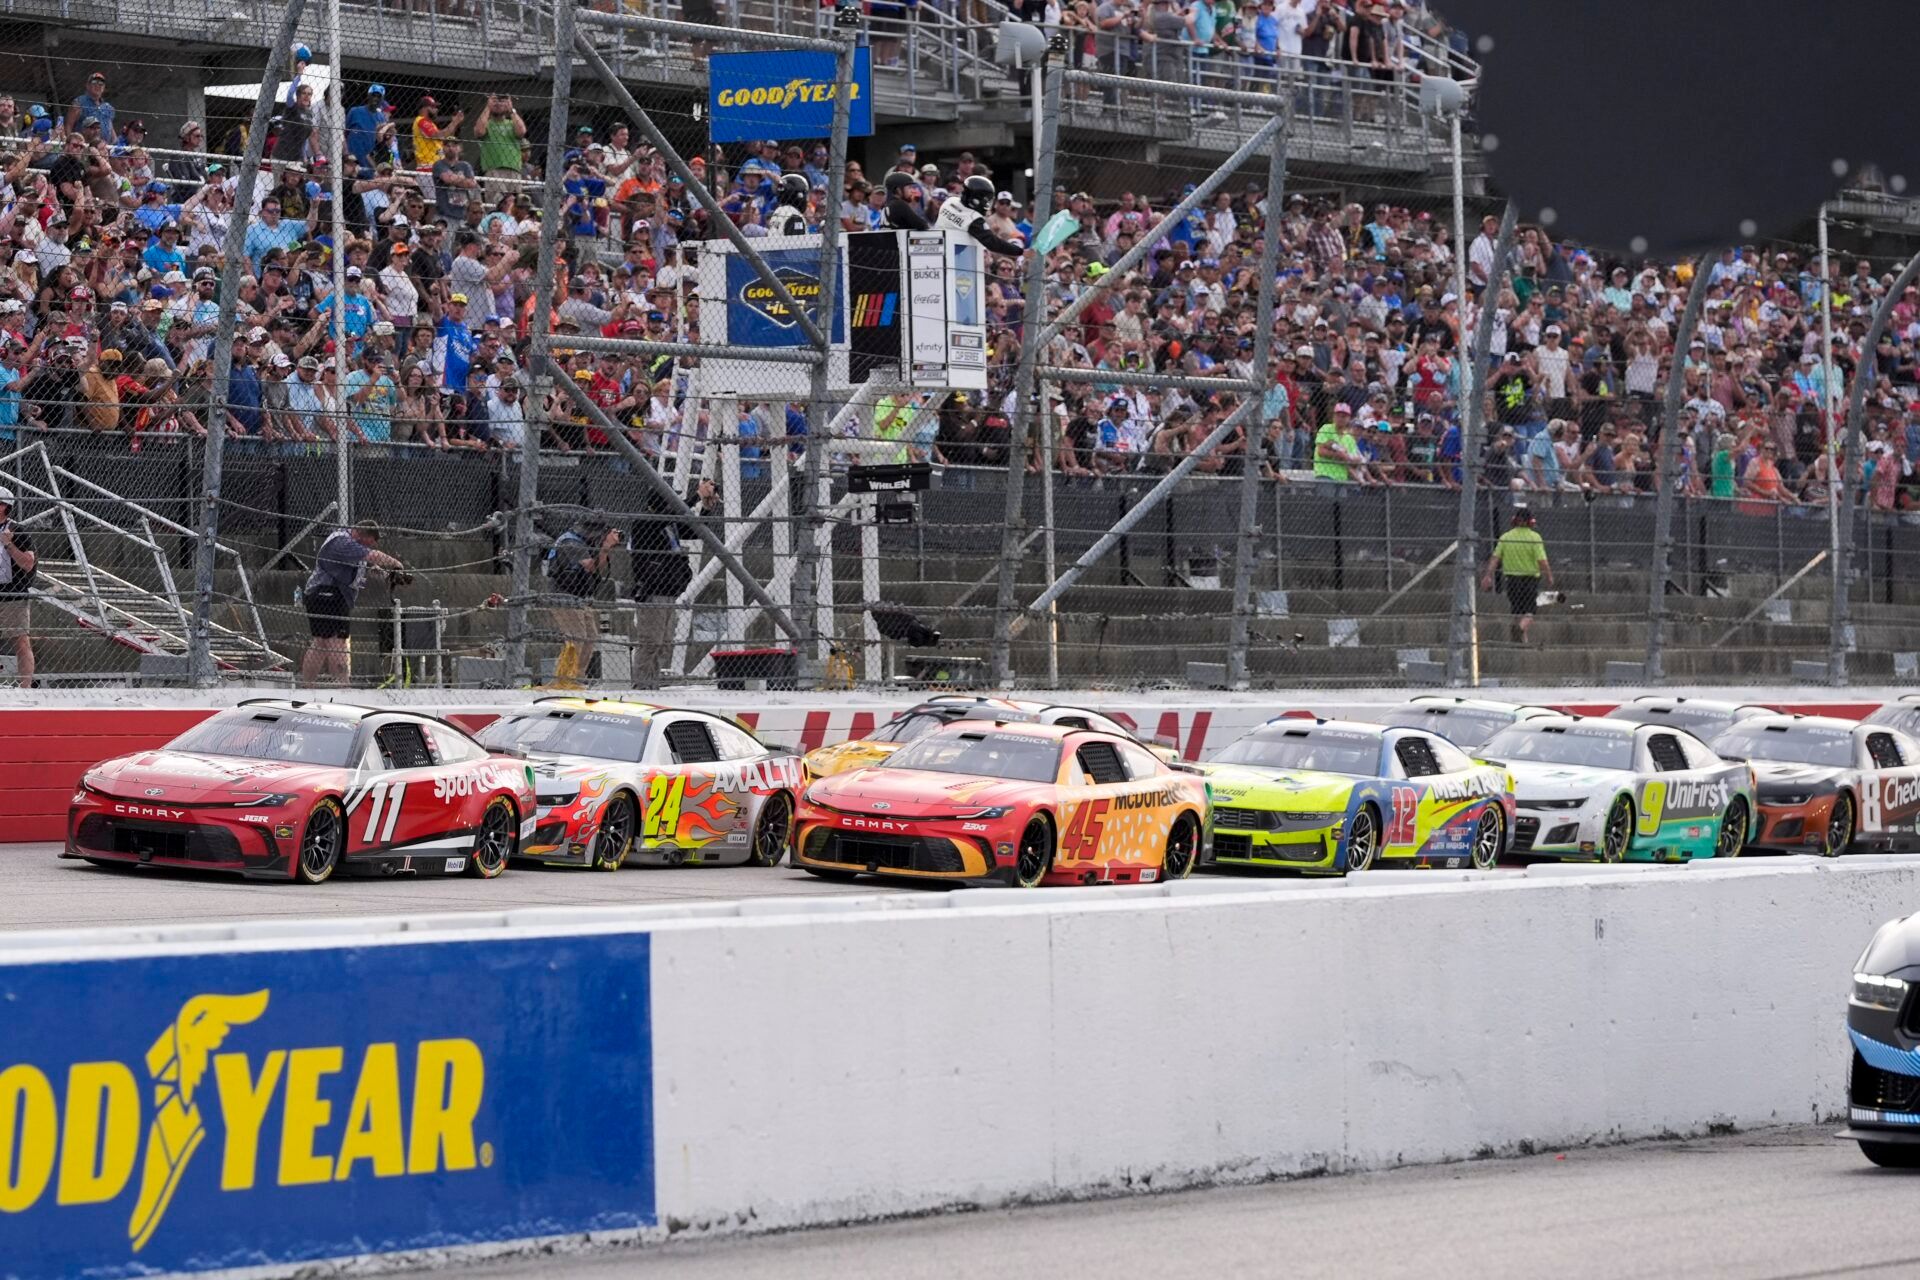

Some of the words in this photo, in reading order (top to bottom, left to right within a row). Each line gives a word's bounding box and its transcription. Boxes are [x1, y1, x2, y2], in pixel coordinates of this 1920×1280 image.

[914, 271, 940, 279] BUSCH
[292, 716, 350, 729] HAMLIN
[583, 714, 630, 725] BYRON
[994, 734, 1049, 745] REDDICK
[711, 758, 801, 793] AXALTA
[1884, 771, 1920, 811] Ched
[643, 775, 686, 838] 24
[1637, 780, 1667, 836] 9
[1667, 778, 1729, 810] UniFirst
[1861, 774, 1883, 832] 8
[115, 804, 184, 818] CAMRY
[239, 814, 269, 823] JGR
[363, 782, 407, 842] 11
[842, 818, 909, 831] CAMRY
[1390, 787, 1418, 846] 12
[1062, 799, 1110, 860] 45
